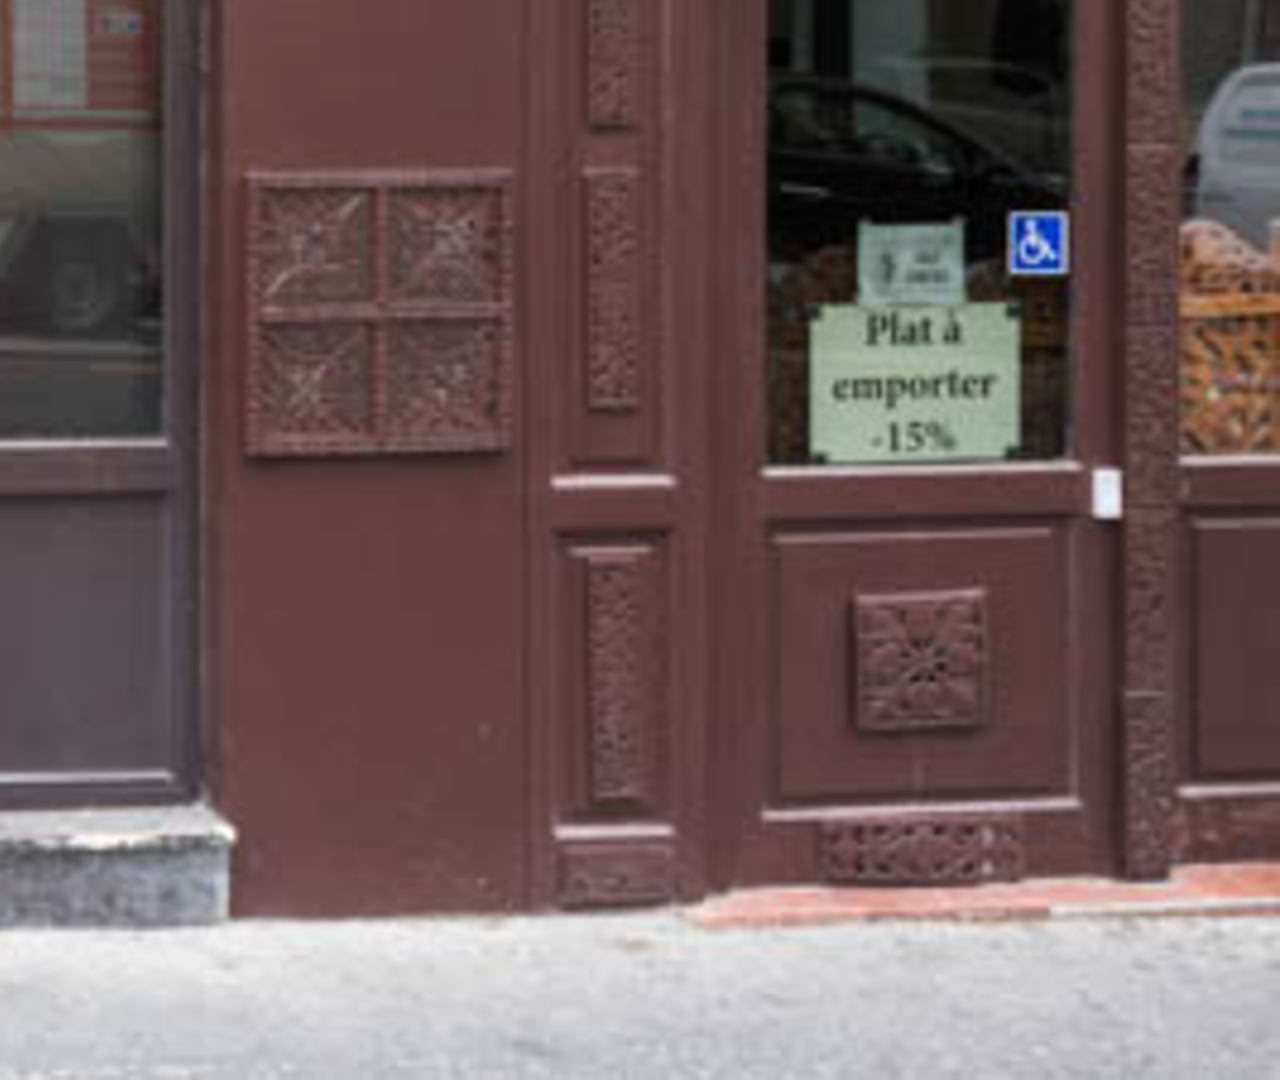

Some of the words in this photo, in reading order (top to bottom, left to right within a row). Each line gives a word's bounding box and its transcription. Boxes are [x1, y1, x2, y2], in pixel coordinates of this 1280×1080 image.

[865, 311, 932, 346] Plat
[943, 310, 963, 345] à
[832, 370, 996, 408] emporter
[872, 422, 956, 452] -15%
